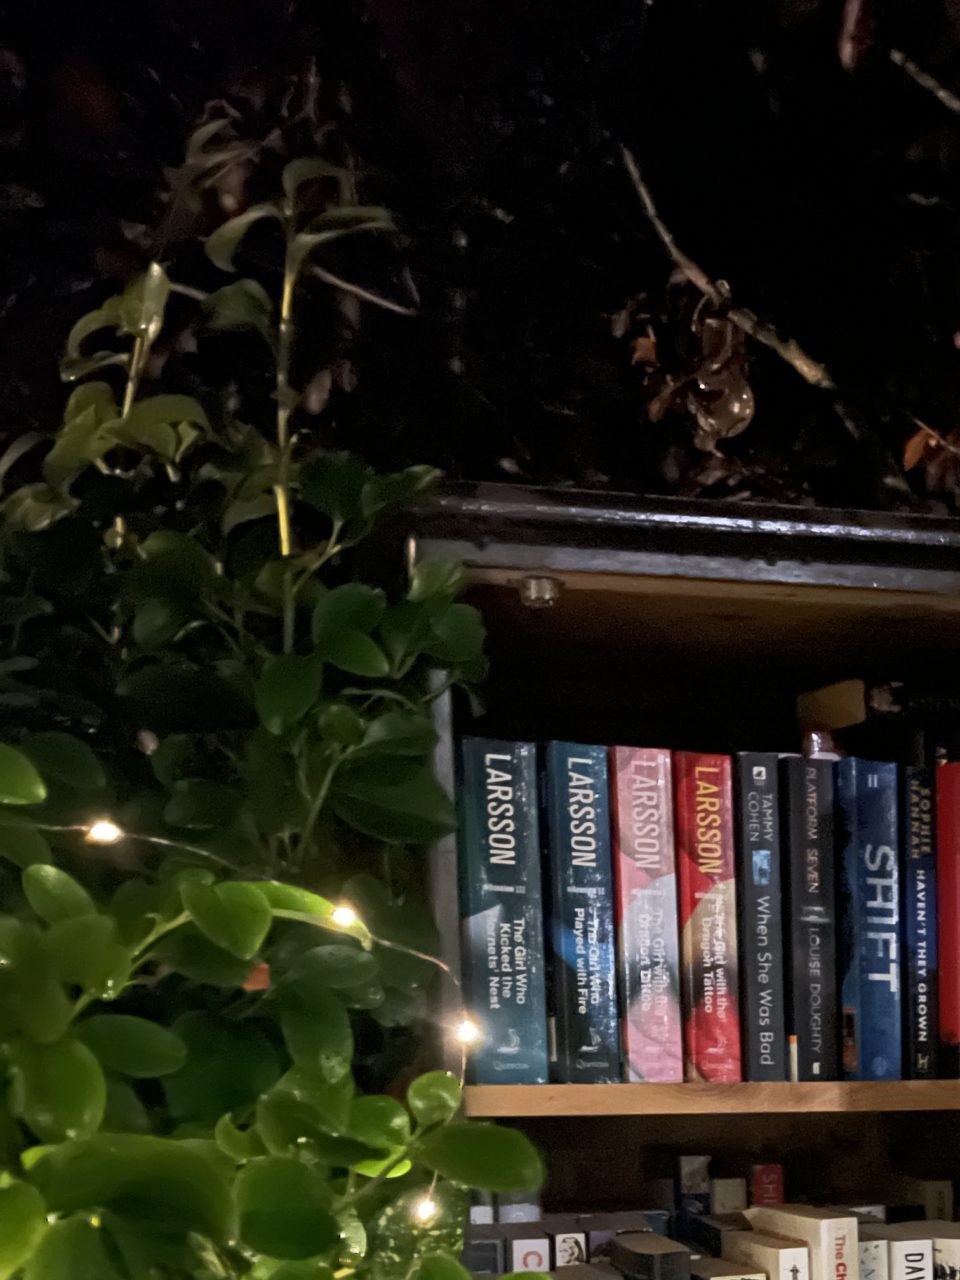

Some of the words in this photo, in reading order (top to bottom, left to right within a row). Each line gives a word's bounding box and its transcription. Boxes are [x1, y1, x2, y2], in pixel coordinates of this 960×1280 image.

[484, 754, 516, 864] LARSSON
[567, 757, 596, 867] LARSSON
[631, 760, 660, 869] LARSSON
[695, 766, 722, 873] LARSSON
[748, 792, 760, 842] COHEN
[762, 792, 774, 842] TAMMY
[806, 767, 818, 840] PLATFORM
[911, 780, 920, 860] HANNAH
[920, 788, 931, 854] SOPHIE
[806, 848, 820, 893] SEVEN
[756, 896, 770, 947] When
[864, 844, 899, 992] SHIFT
[916, 870, 928, 936] HAVEN'T
[500, 923, 512, 972] Kicked
[513, 918, 526, 942] The
[574, 908, 586, 954] Played
[588, 920, 599, 944] The
[700, 917, 714, 967] Dragon
[808, 928, 822, 977] LOUISE
[514, 946, 526, 970] Girl
[576, 958, 588, 985] with
[588, 948, 600, 971] Girl
[757, 952, 772, 984] She
[916, 941, 928, 978] THEY
[488, 977, 500, 1009] Nest
[502, 976, 513, 998] the
[515, 974, 528, 1004] Who
[578, 988, 588, 1014] Fire
[589, 974, 601, 1004] Who
[703, 972, 714, 1013] Tattoo
[715, 968, 726, 997] with
[716, 1000, 727, 1018] the
[758, 989, 772, 1026] Was
[808, 984, 822, 1054] DOUGHTY
[916, 983, 928, 1042] GROWN
[759, 1032, 775, 1066] Bad
[834, 1235, 846, 1260] The
